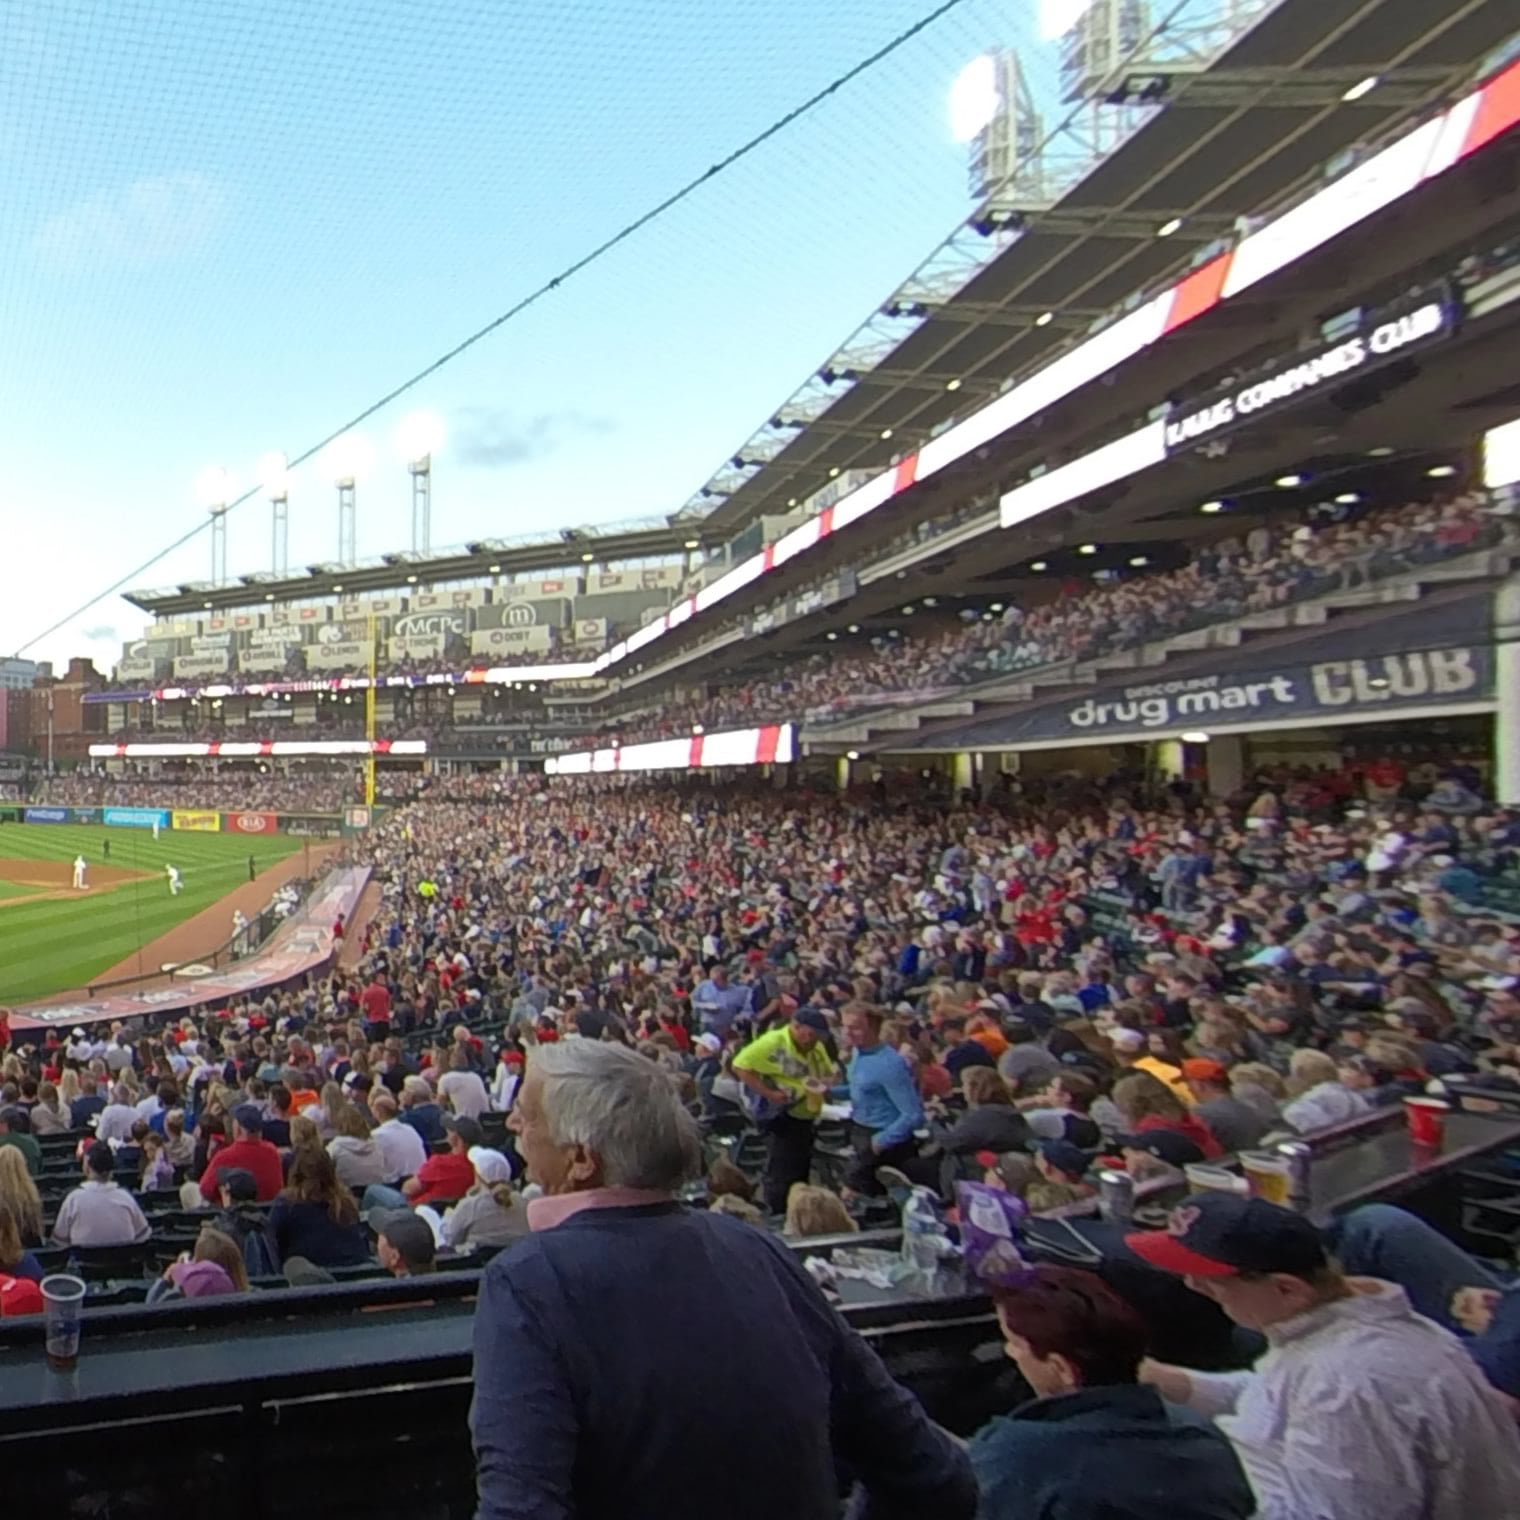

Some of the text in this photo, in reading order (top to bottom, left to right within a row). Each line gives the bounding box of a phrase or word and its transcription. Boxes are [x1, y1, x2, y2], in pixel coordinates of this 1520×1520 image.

[1236, 337, 1367, 415] COMPANIES
[1369, 302, 1443, 354] CLUB
[1068, 647, 1477, 727] drug mart CLUB
[1125, 675, 1219, 700] DISCOUNT
